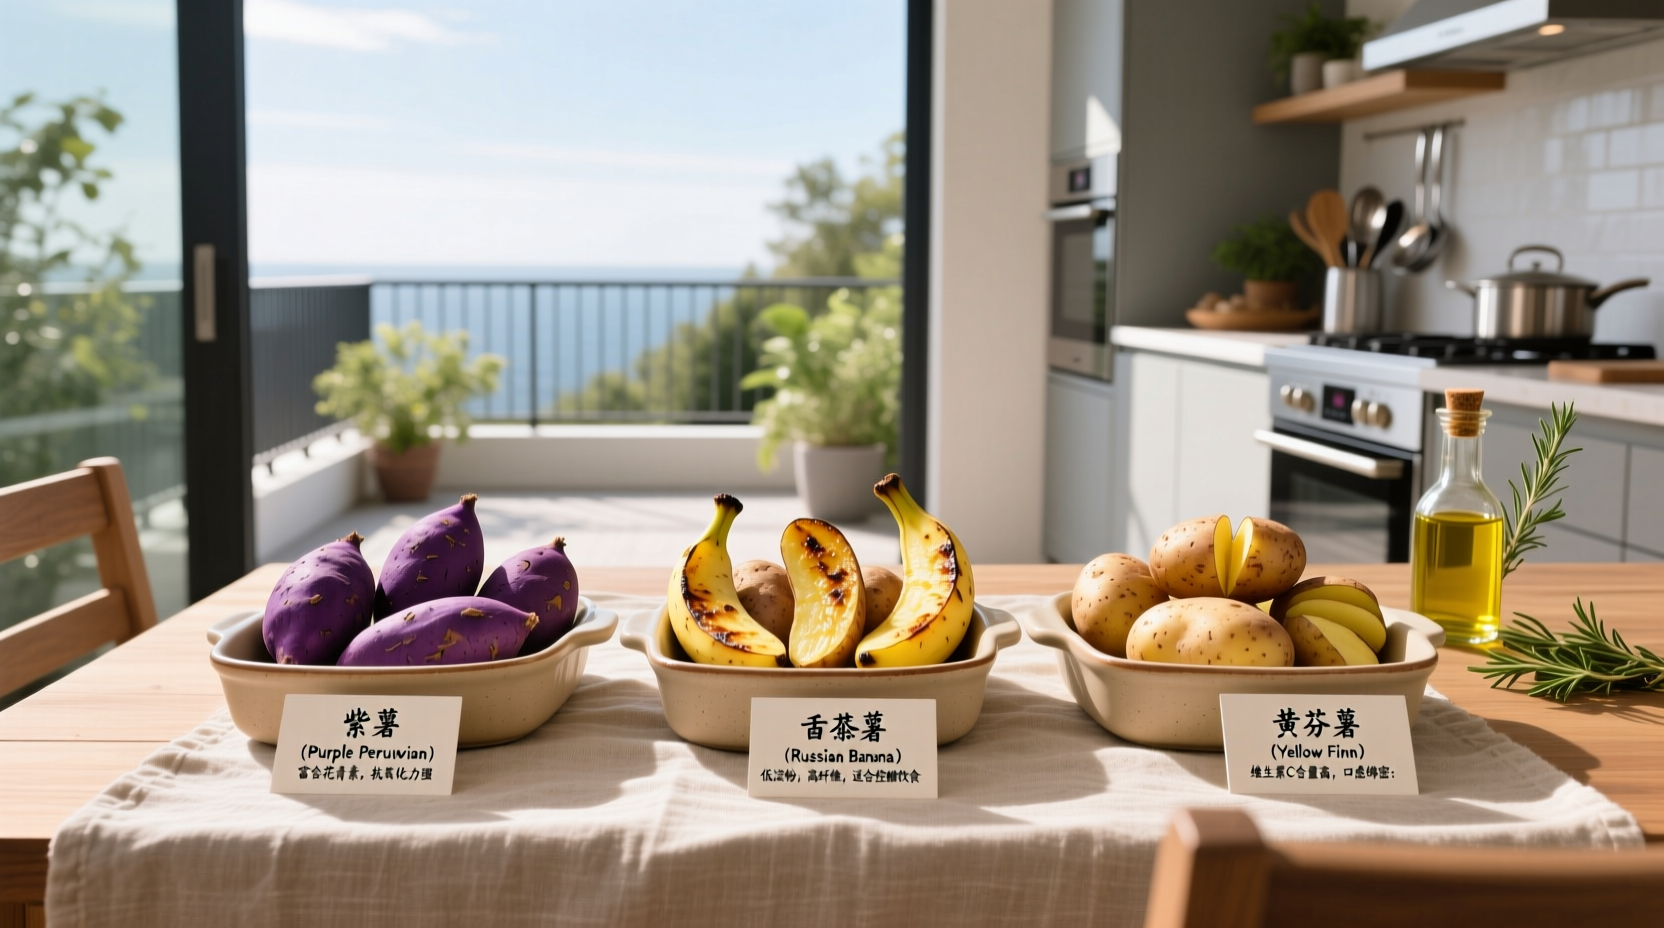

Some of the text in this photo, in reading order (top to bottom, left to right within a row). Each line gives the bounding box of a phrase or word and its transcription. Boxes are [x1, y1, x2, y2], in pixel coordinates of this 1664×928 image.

[343, 707, 400, 739] 紫薯
[1272, 707, 1360, 739] 黄芬薯
[301, 743, 354, 764] (Purple
[784, 747, 844, 764] (Russian
[1270, 743, 1365, 761] (Yellow Finn)
